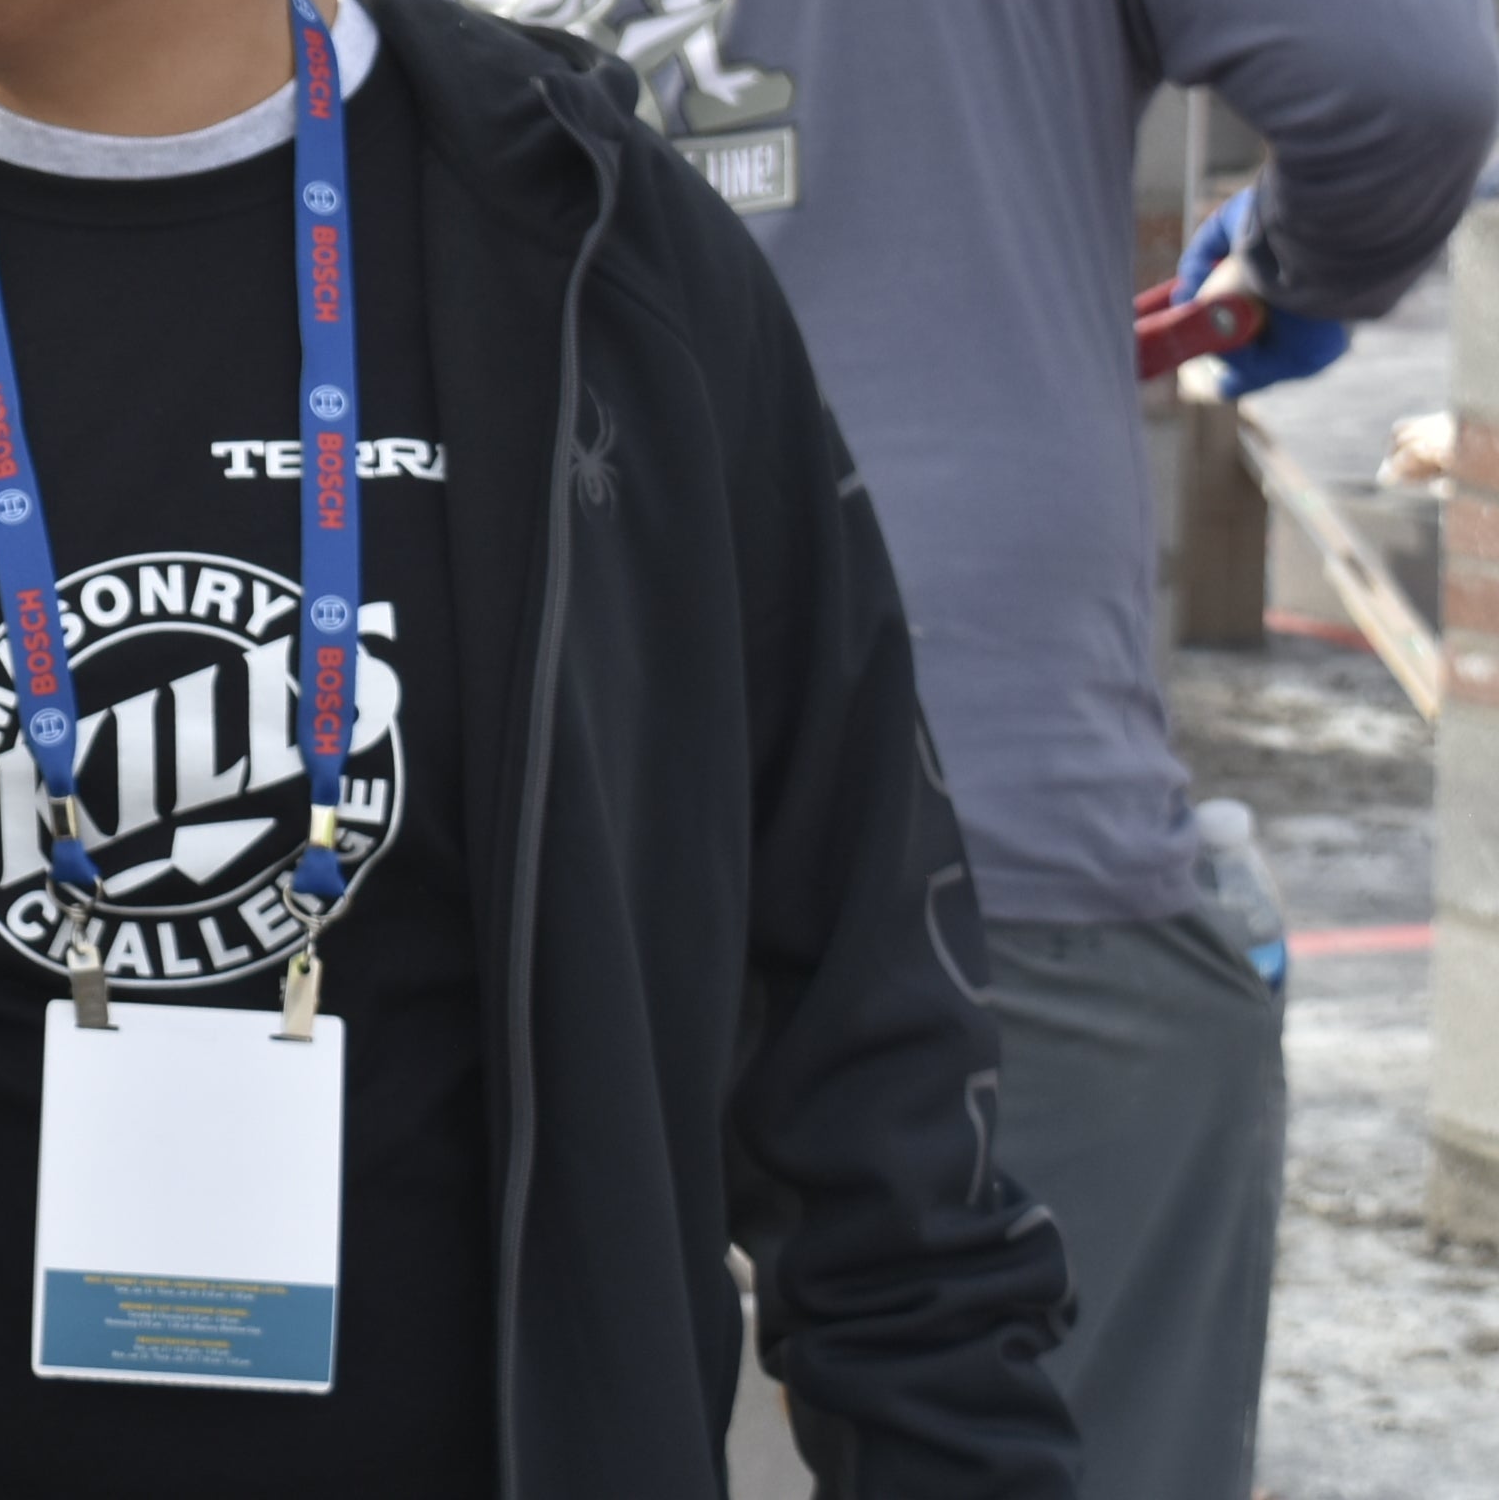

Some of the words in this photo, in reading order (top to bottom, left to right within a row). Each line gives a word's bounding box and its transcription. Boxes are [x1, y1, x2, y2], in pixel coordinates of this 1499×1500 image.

[302, 28, 332, 120] BOSCH
[311, 225, 340, 323] BOSCH
[317, 432, 346, 530] BOSCH
[16, 589, 59, 696] BOSCH
[315, 647, 345, 756] BOSCH
[6, 776, 388, 978] CHALLEGE
